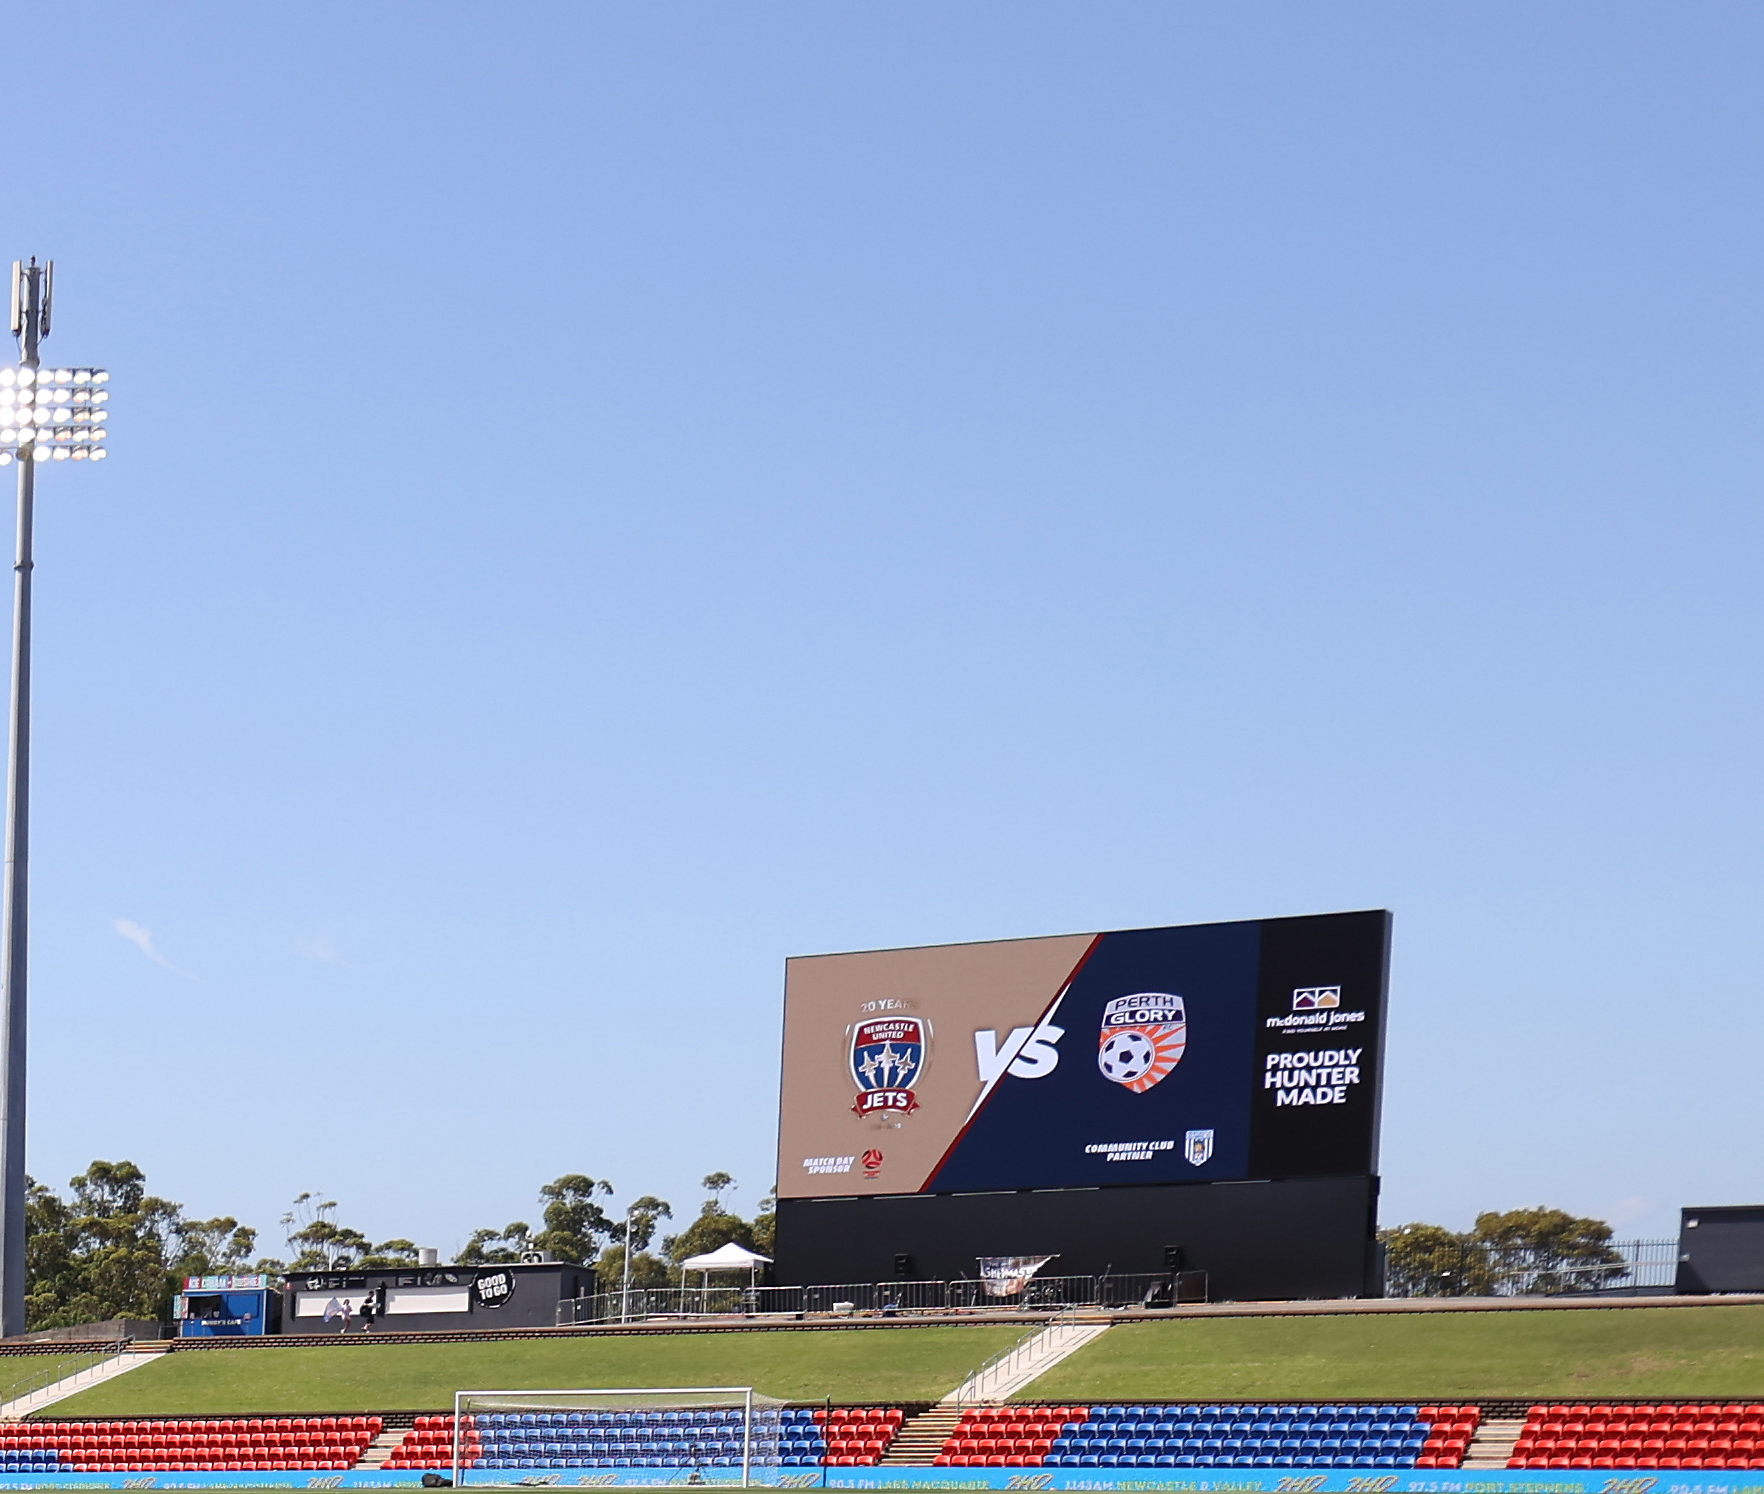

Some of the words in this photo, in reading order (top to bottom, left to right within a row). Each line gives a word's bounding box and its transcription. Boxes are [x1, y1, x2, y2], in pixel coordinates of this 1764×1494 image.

[861, 1001, 876, 1013] 20
[1114, 996, 1174, 1011] PERTH
[1110, 1009, 1176, 1025] GLORY
[1328, 1010, 1365, 1026] jones
[864, 1022, 915, 1035] NEWCASTLE
[872, 1031, 904, 1041] UNITED
[974, 1024, 1066, 1082] VS
[1266, 1047, 1362, 1070] PROUDLY
[1264, 1066, 1360, 1089] HUNTER
[862, 1092, 908, 1110] JETS
[1276, 1085, 1347, 1107] MADE
[1085, 1141, 1148, 1154] COMMUNITY
[1149, 1140, 1174, 1151] CLUB
[803, 1156, 834, 1168] MATCH
[836, 1156, 855, 1167] DAY
[1106, 1150, 1153, 1162] PARTNER
[808, 1165, 850, 1175] SPONSOR
[477, 1273, 507, 1290] GOOD
[479, 1288, 493, 1300] TO
[493, 1284, 508, 1297] GO
[829, 1479, 855, 1488] 90.5
[858, 1480, 875, 1489] FM
[1065, 1480, 1113, 1490] 1143AM
[1117, 1481, 1196, 1492] NEWCASTLE
[1213, 1481, 1262, 1492] VALLEY
[1408, 1481, 1438, 1492] 97.5
[1442, 1482, 1461, 1492] FM
[1466, 1482, 1504, 1493] PORT
[1509, 1482, 1584, 1494] STEPHENS
[1707, 1485, 1728, 1494] FM
